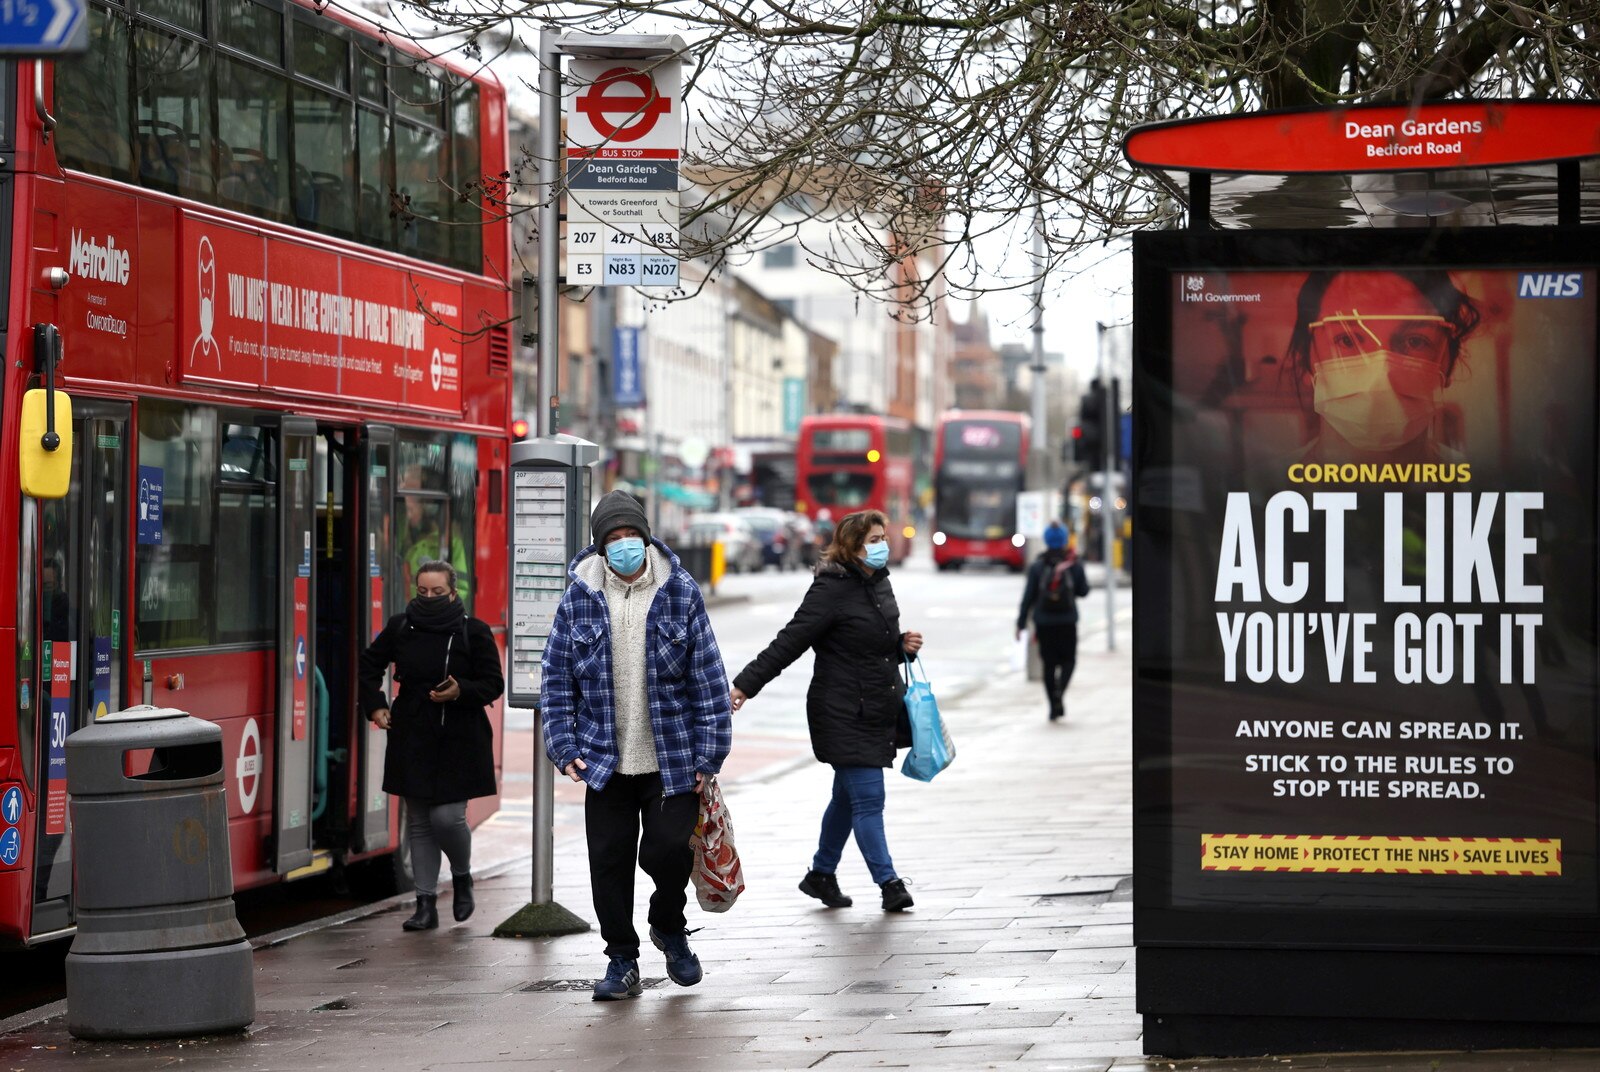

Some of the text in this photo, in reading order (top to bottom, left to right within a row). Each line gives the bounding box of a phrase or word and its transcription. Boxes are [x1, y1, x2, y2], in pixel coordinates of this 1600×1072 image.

[1345, 119, 1482, 138] Dean Gardens
[602, 149, 643, 157] BUS STOP
[1366, 141, 1462, 157] Bedford Road
[588, 164, 658, 174] Dean Gardens
[620, 198, 658, 206] Greenford
[574, 232, 596, 243] 207
[611, 232, 634, 244] 427
[651, 232, 673, 244] 483
[69, 226, 130, 286] Metroline
[577, 263, 593, 275] E3
[609, 263, 636, 275] N83
[643, 264, 676, 275] N207
[1519, 273, 1580, 297] NHS
[1186, 292, 1261, 302] HM Government
[228, 272, 425, 352] YOU MUST WEAR A FACE COVERING ON PUBLIC TRANSPORT
[234, 340, 243, 356] you
[243, 339, 250, 355] do
[270, 346, 279, 362] may
[1287, 463, 1472, 484] CORONAVIRUS
[1214, 490, 1544, 604] ACT LIKE
[141, 576, 160, 610] 483
[1216, 611, 1543, 685] YOU'VE GOT IT
[53, 659, 70, 668] Maximum
[54, 673, 68, 683] capacity
[52, 711, 66, 748] 30
[1235, 720, 1524, 740] ANYONE CAN SPREAD IT.
[244, 760, 255, 772] BUSES
[1245, 754, 1514, 775] STICK TO THE RULES TO
[1272, 779, 1486, 799] STOP THE SPREAD.
[1213, 845, 1549, 864] STAY HOME PROTECT THE NHS SAVE LIVES
